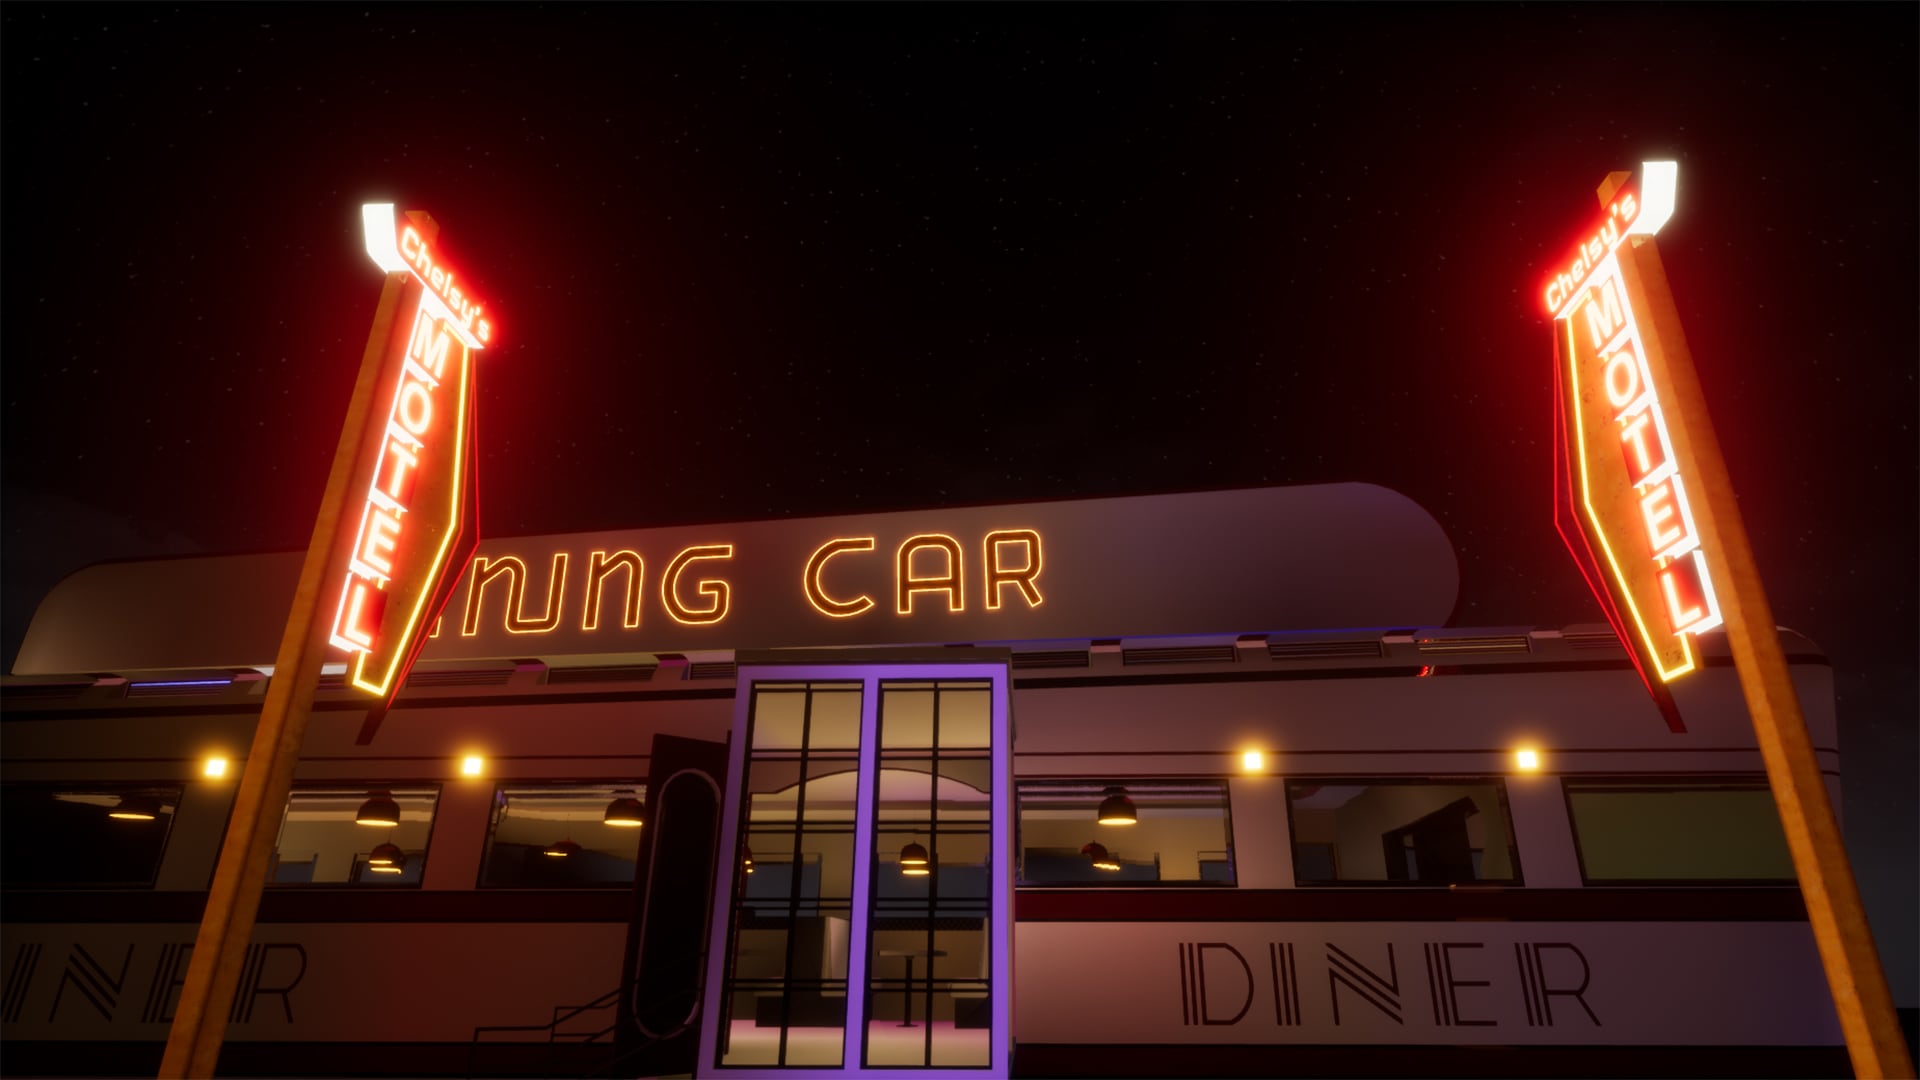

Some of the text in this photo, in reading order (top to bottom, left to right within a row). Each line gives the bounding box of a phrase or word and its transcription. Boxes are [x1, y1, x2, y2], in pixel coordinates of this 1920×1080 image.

[400, 226, 490, 343] Chelsy's
[1545, 192, 1637, 314] Chelsy's
[343, 311, 449, 648] MOTEL
[1585, 277, 1703, 635] MOTEL
[429, 528, 1044, 639] NING CAR
[1178, 942, 1602, 1027] DINER
